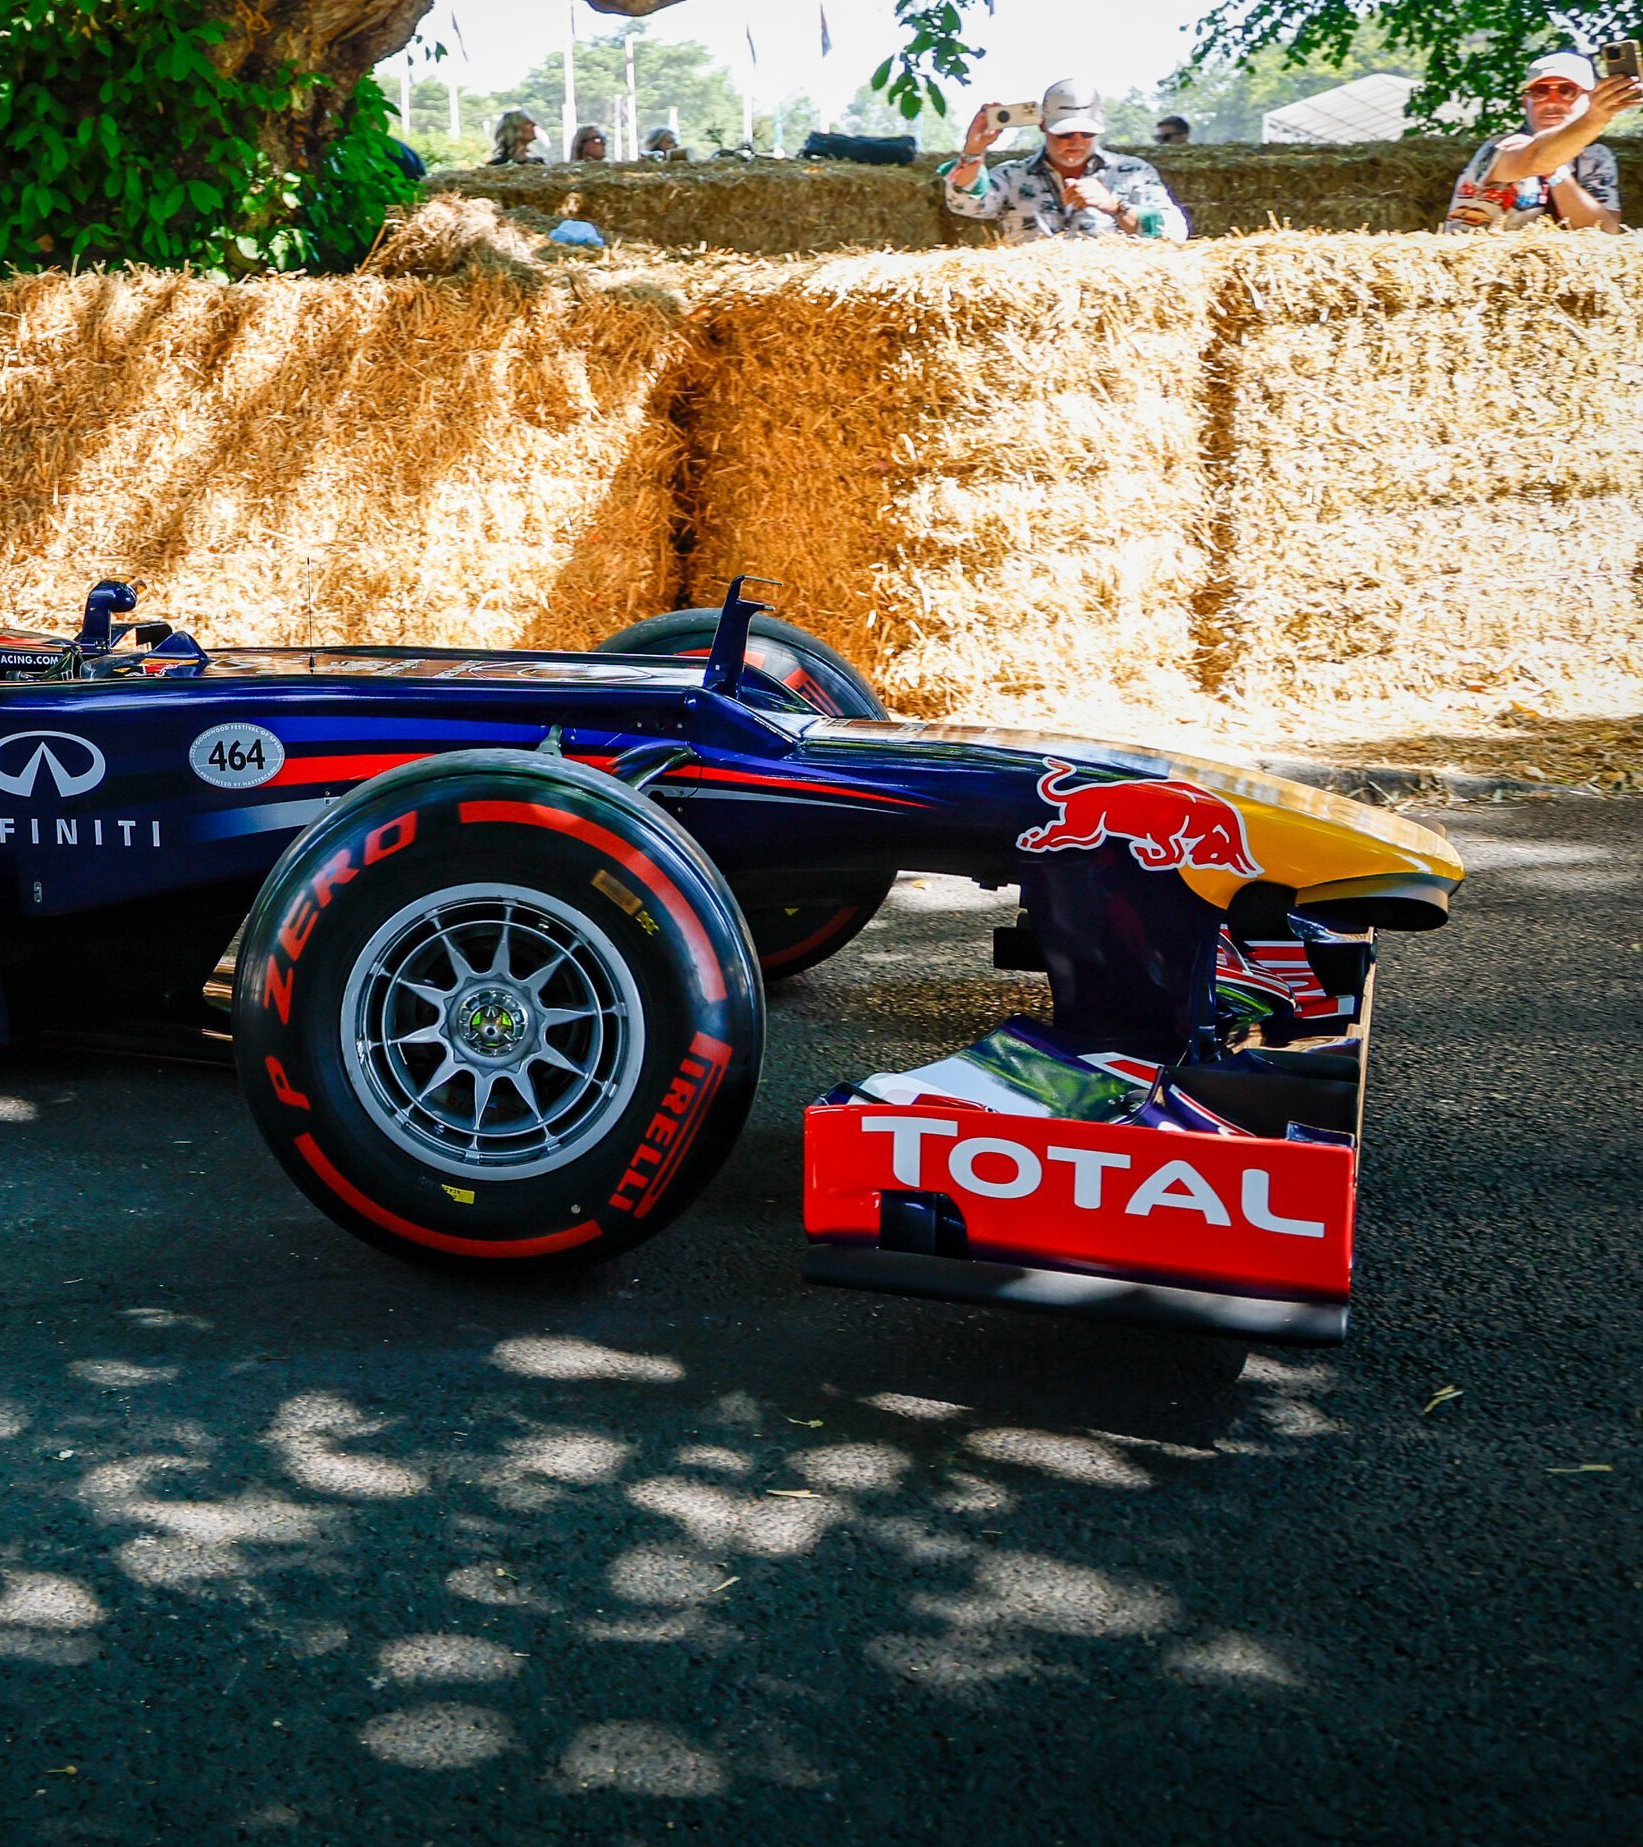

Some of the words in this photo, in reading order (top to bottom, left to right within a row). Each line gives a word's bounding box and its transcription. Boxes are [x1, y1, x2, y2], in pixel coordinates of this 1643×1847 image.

[195, 725, 230, 746] GOODWOOD
[230, 725, 260, 734] FESTIVAL
[260, 730, 270, 738] OF
[268, 735, 283, 754] SPEED
[208, 738, 266, 772] 464
[199, 771, 232, 788] PRESENTED
[263, 810, 419, 1026] ZERO
[264, 1055, 312, 1111] P
[608, 1030, 734, 1219] PIRELLI
[860, 1115, 1325, 1239] TOTAL
